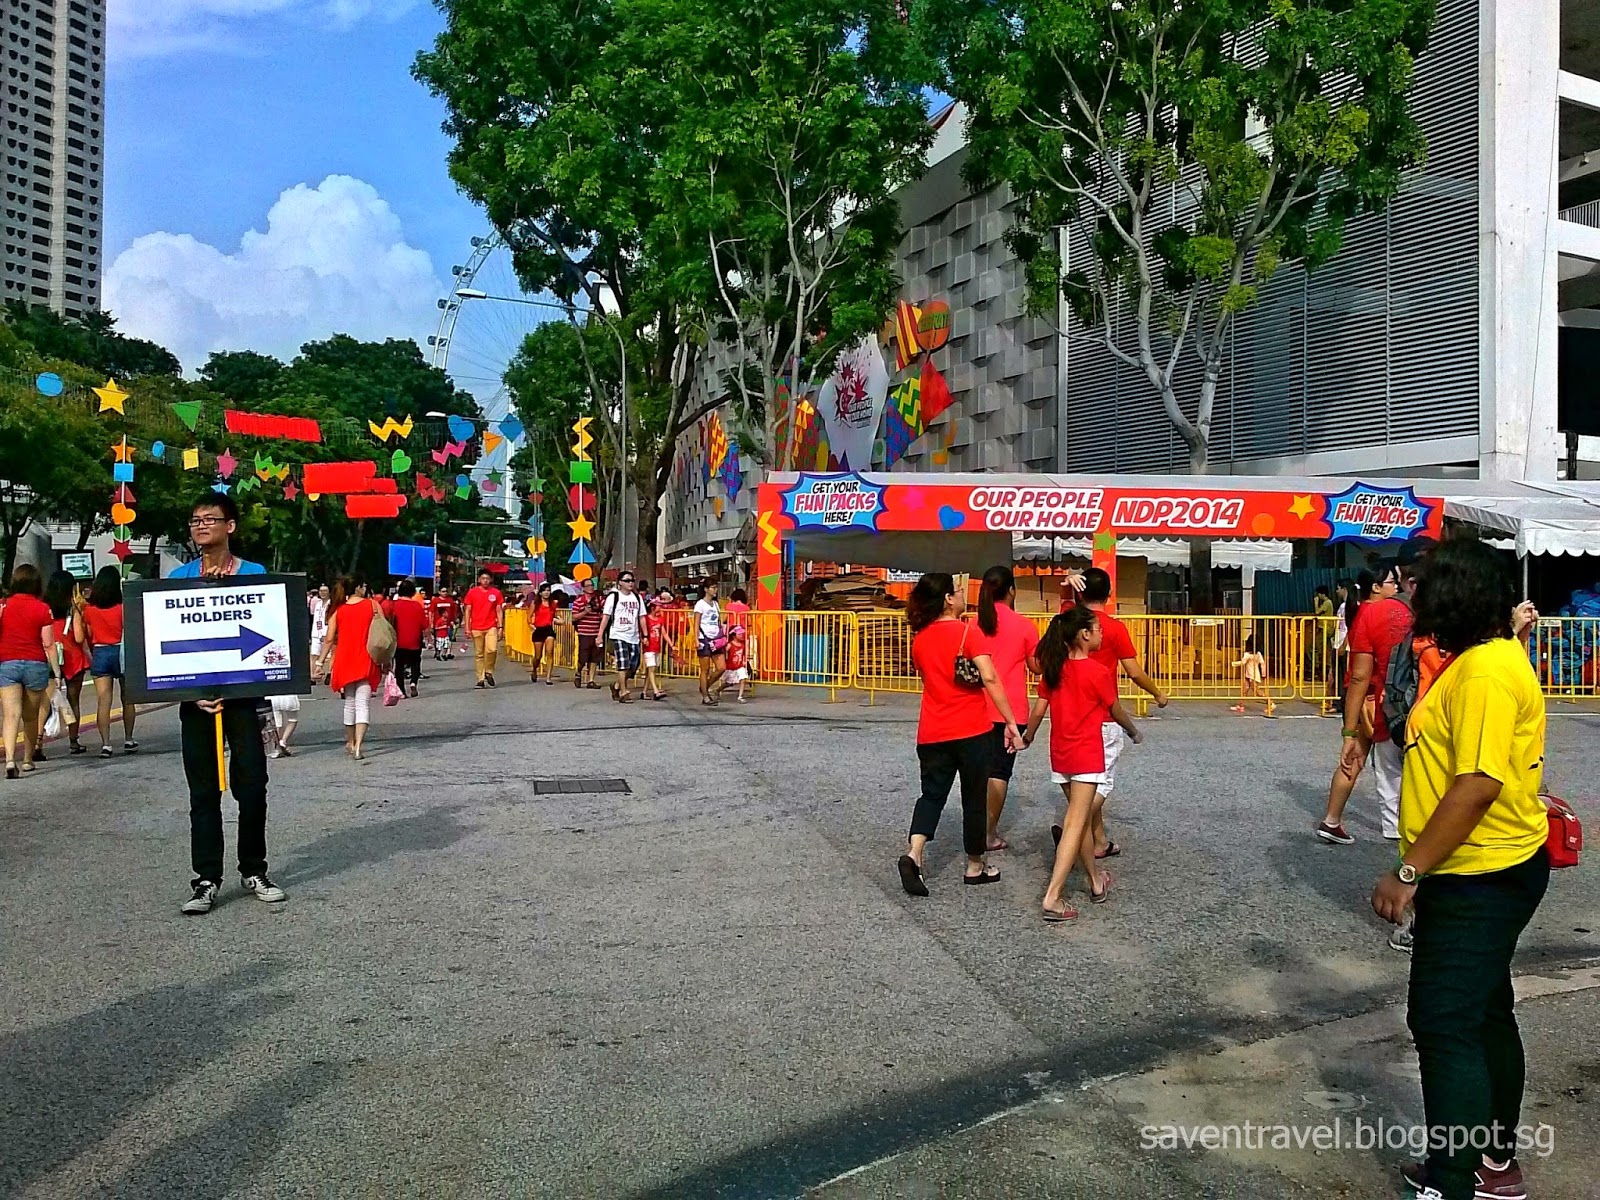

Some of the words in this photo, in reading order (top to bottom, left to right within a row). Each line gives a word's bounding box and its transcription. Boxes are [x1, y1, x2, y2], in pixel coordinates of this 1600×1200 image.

[812, 483, 831, 494] GET
[832, 482, 858, 494] YOUR
[795, 493, 826, 512] FUN
[827, 492, 877, 512] PACKS
[972, 491, 1016, 509] OUR
[1018, 491, 1102, 510] PEOPLE
[1355, 494, 1375, 505] GET
[1375, 495, 1403, 507] YOUR
[824, 511, 853, 524] HERE!
[989, 510, 1033, 529] OUR
[1035, 511, 1100, 529] HOME
[1114, 500, 1239, 524] NDP2014
[1335, 503, 1365, 523] FUN
[1366, 506, 1418, 526] PACKS
[1362, 524, 1393, 538] HERE!
[165, 597, 206, 610] BLUE
[209, 593, 266, 606] TICKET
[180, 609, 252, 624] HOLDERS
